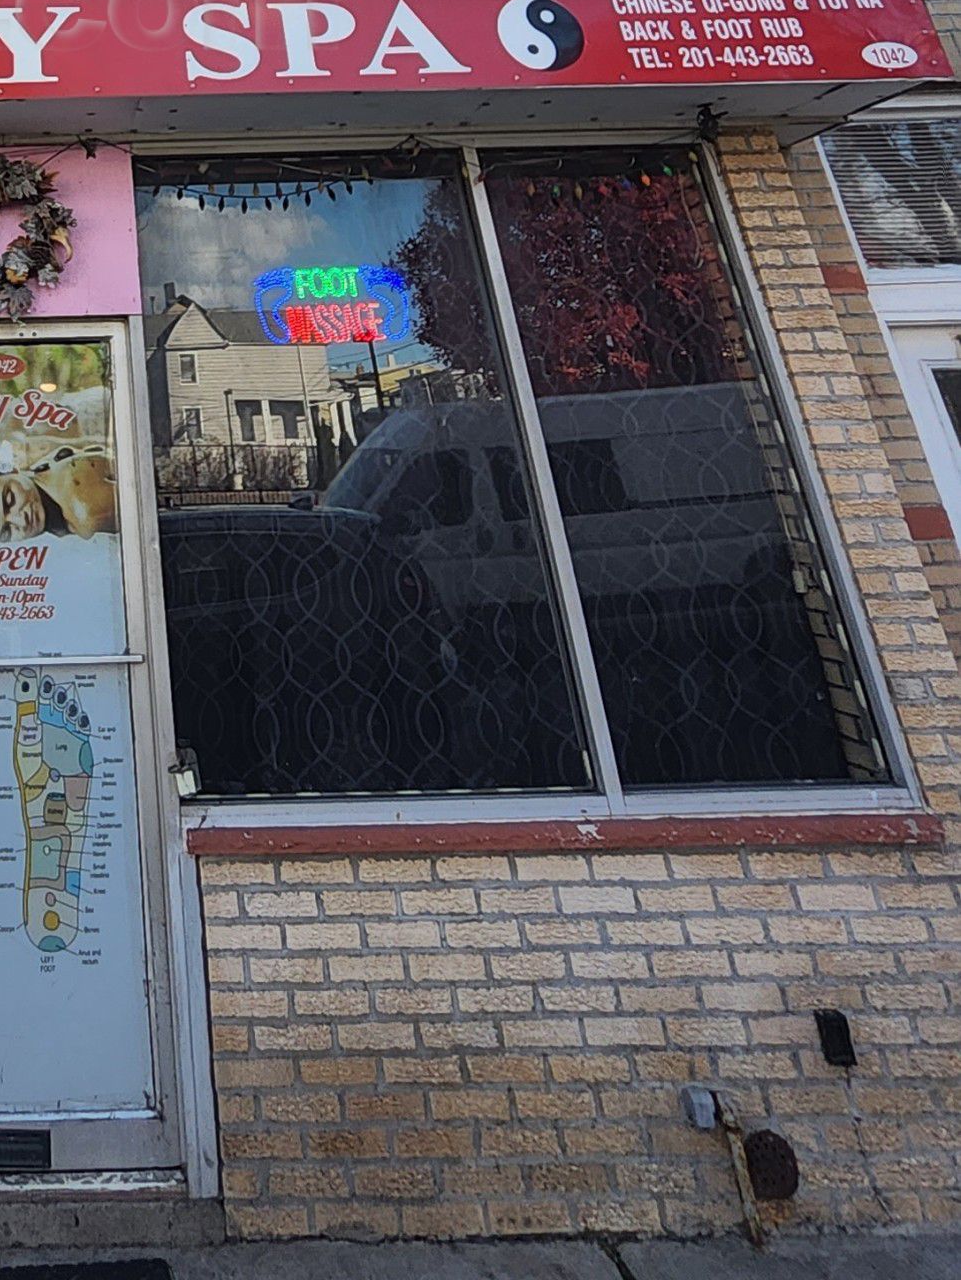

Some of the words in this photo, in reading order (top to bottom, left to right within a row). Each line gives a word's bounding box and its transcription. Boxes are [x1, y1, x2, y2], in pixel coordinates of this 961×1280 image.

[619, 21, 675, 42] BACK
[681, 21, 698, 40] &
[702, 19, 756, 40] FOOT
[762, 17, 803, 39] RUB
[627, 47, 673, 69] TEL:
[678, 45, 814, 69] 201-443-2663
[870, 46, 908, 64] 1042
[295, 267, 359, 299] FOOT
[285, 302, 387, 344] MASSAGE
[13, 390, 77, 431] Spa
